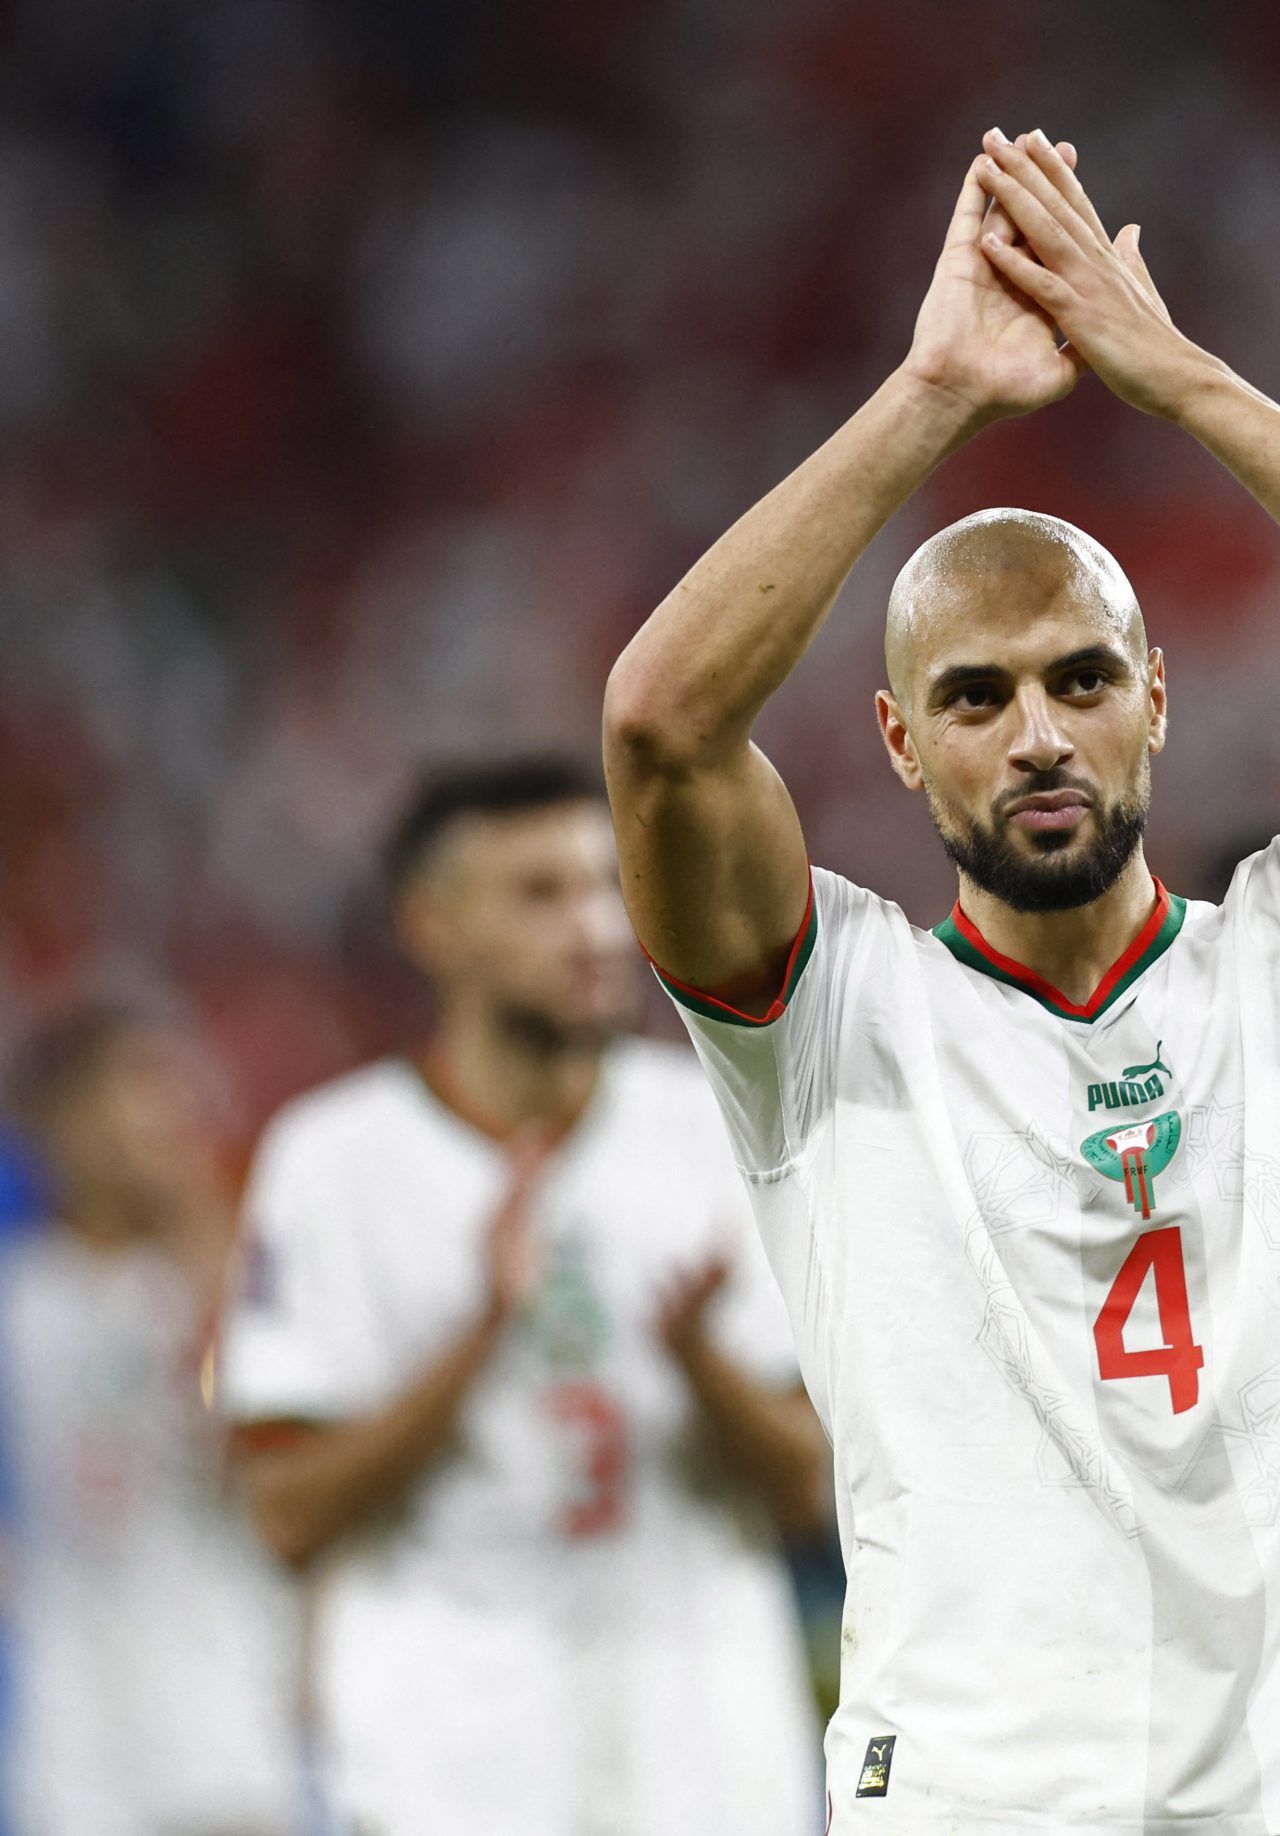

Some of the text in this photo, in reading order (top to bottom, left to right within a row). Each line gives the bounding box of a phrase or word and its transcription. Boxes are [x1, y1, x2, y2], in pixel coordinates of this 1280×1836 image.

[1088, 1074, 1164, 1111] PUMA
[1123, 1164, 1148, 1177] FRMF
[1093, 1226, 1204, 1414] 4
